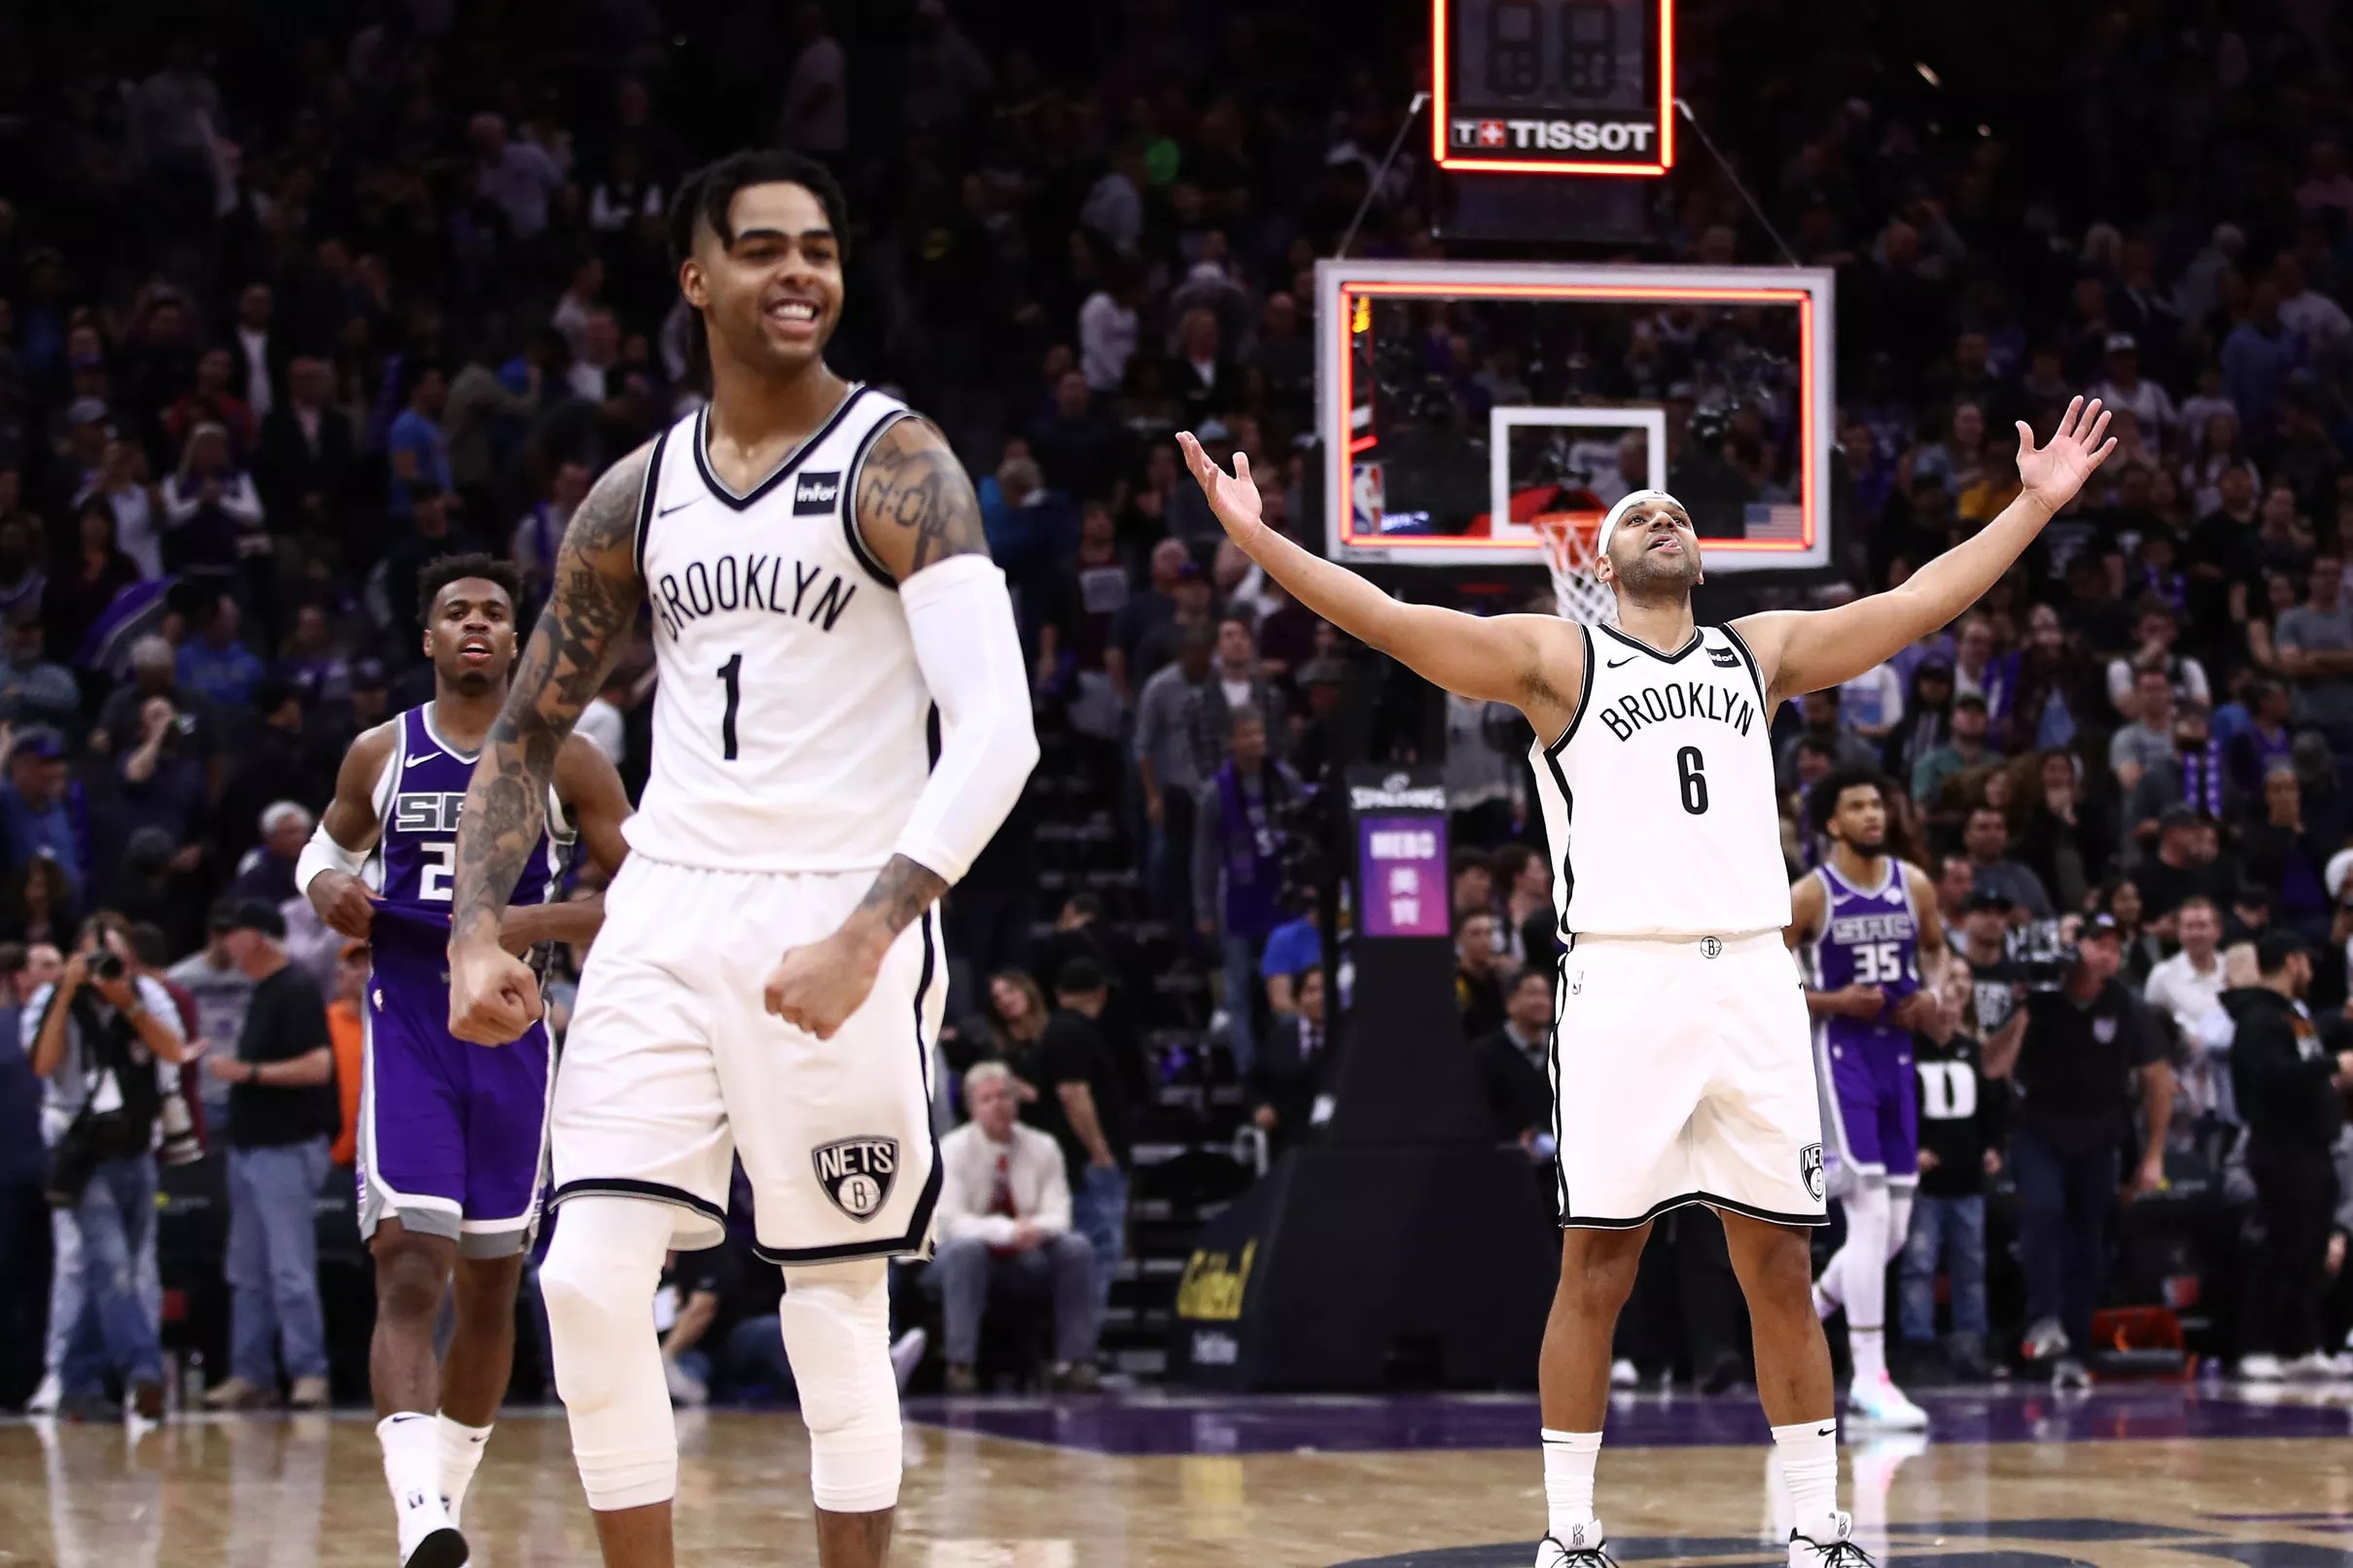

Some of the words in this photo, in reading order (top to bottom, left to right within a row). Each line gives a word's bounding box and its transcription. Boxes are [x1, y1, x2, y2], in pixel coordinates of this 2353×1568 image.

[1508, 120, 1655, 152] TISSOT
[797, 482, 836, 502] infor
[717, 653, 742, 760] 1
[1599, 681, 1754, 743] BROOKLYN
[1677, 746, 1708, 816] 6
[419, 843, 456, 901] 2
[1852, 943, 1901, 983] 35
[820, 1142, 895, 1181] NETS
[853, 1182, 867, 1208] B
